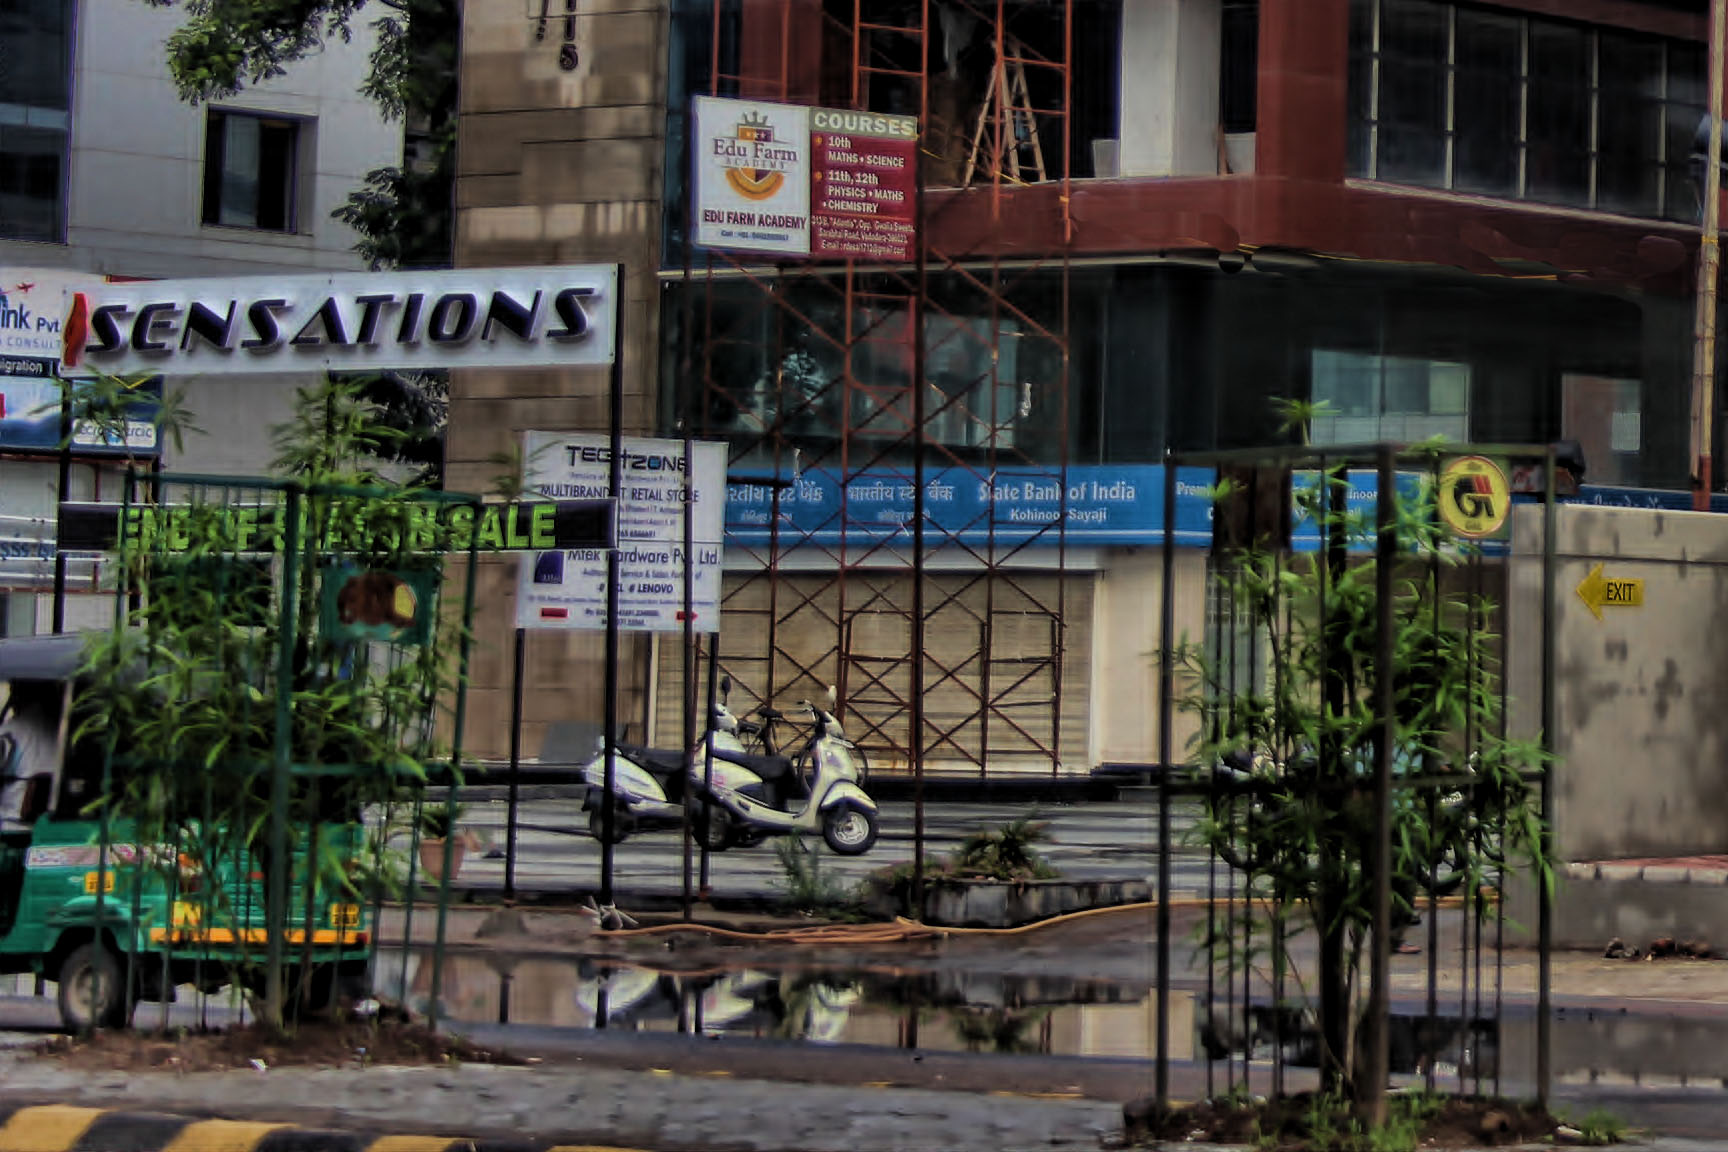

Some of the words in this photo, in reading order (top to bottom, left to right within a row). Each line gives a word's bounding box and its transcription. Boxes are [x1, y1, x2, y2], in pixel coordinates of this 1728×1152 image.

[814, 112, 914, 135] COURSES
[713, 138, 747, 157] Edu
[754, 142, 797, 161] Farm
[828, 136, 851, 148] 10th
[726, 157, 785, 170] ACADEMY
[828, 151, 859, 163] MATHS
[866, 155, 904, 167] SCIENCE
[828, 186, 866, 198] PHYSICS
[874, 190, 904, 201] MATHS
[828, 201, 878, 213] CHEMISTRY
[704, 209, 724, 223] EDU
[727, 211, 755, 226] FARM
[758, 214, 807, 229] ACADEMY
[0, 303, 31, 329] ink
[86, 287, 595, 353] SENSATIONS
[7, 337, 61, 349] CONSULT
[0, 356, 43, 375] igration
[632, 488, 663, 502] RETAIL
[1069, 482, 1086, 501] of
[1093, 481, 1136, 501] India
[1011, 507, 1061, 522] Kohinoo
[1069, 507, 1107, 523] Sayaji
[450, 503, 558, 549] SALE
[699, 549, 721, 565] Ltd.
[638, 584, 673, 594] LENOVO
[1607, 583, 1635, 601] EXIT
